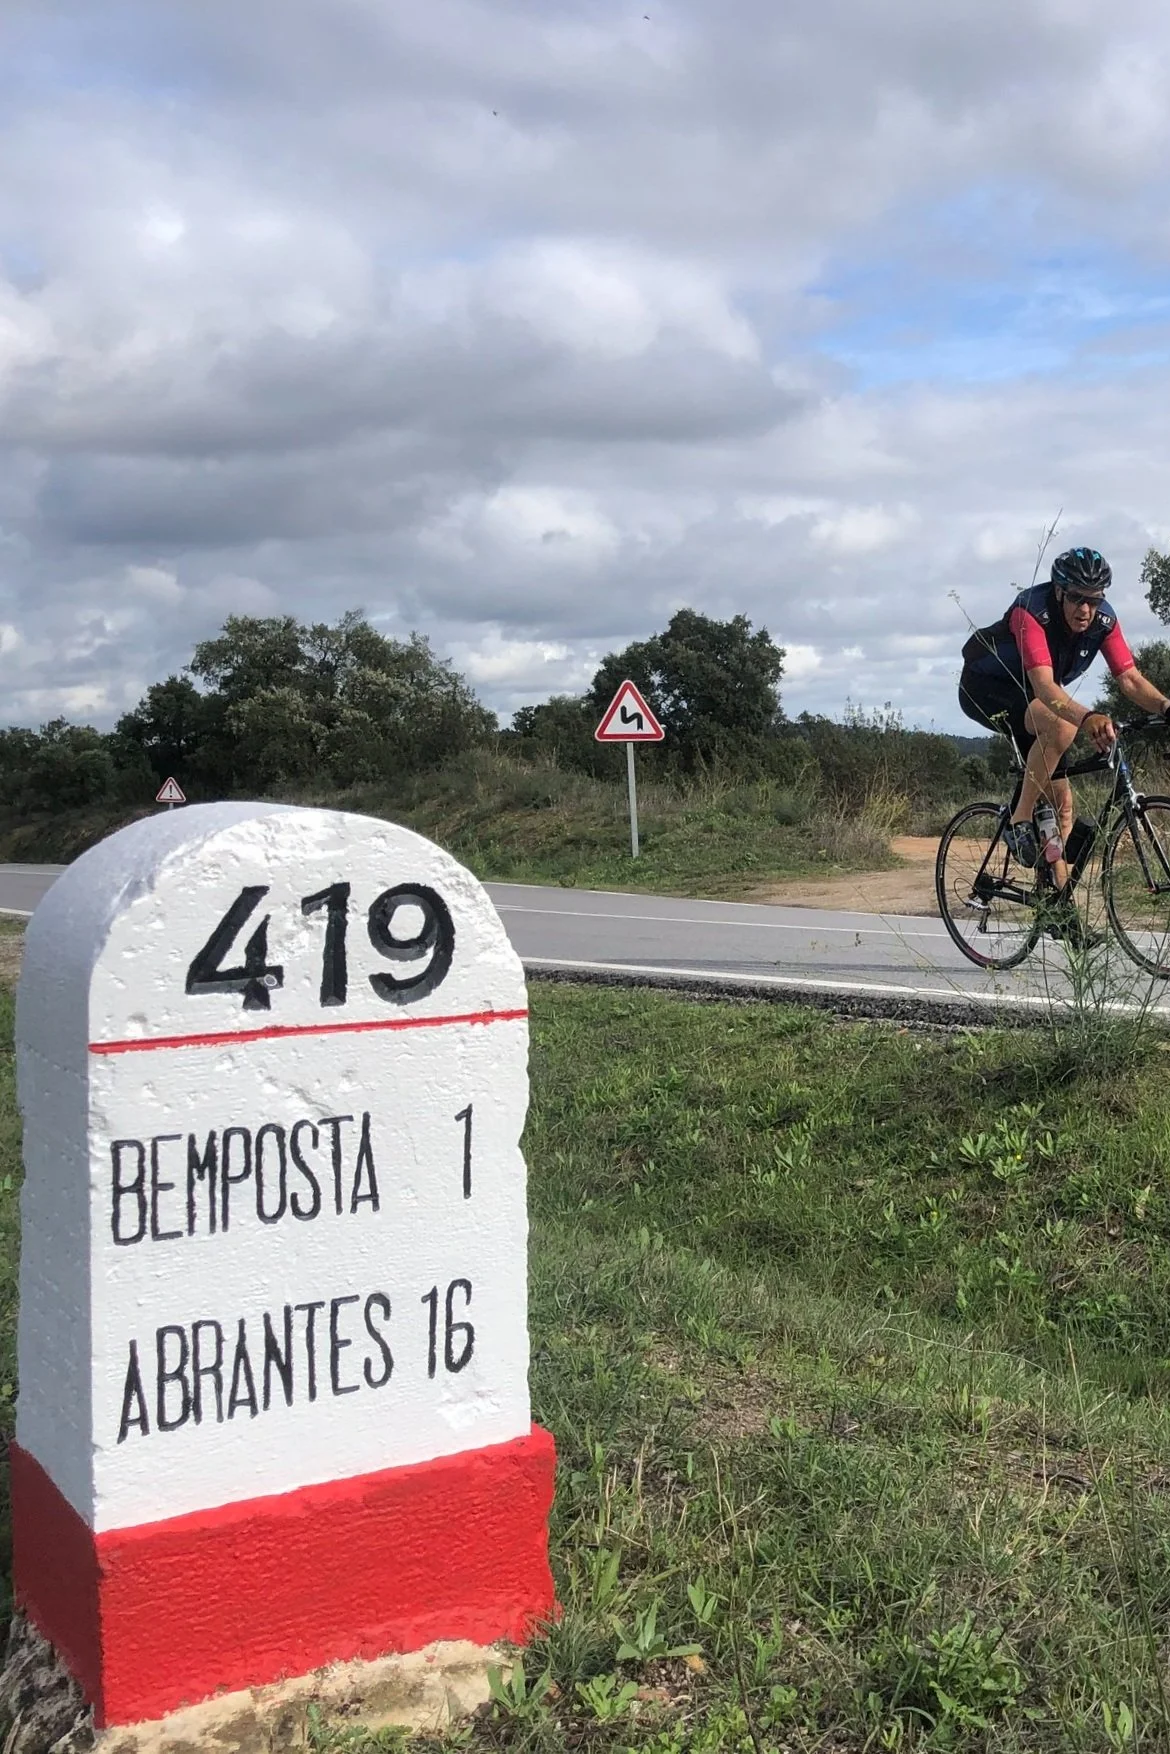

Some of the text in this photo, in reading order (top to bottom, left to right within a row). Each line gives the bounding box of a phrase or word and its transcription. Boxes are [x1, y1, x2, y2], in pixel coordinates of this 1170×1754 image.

[185, 881, 456, 1010] 419
[110, 1103, 473, 1246] BEMPOSTA 1
[117, 1278, 475, 1444] ABRANTES 16
